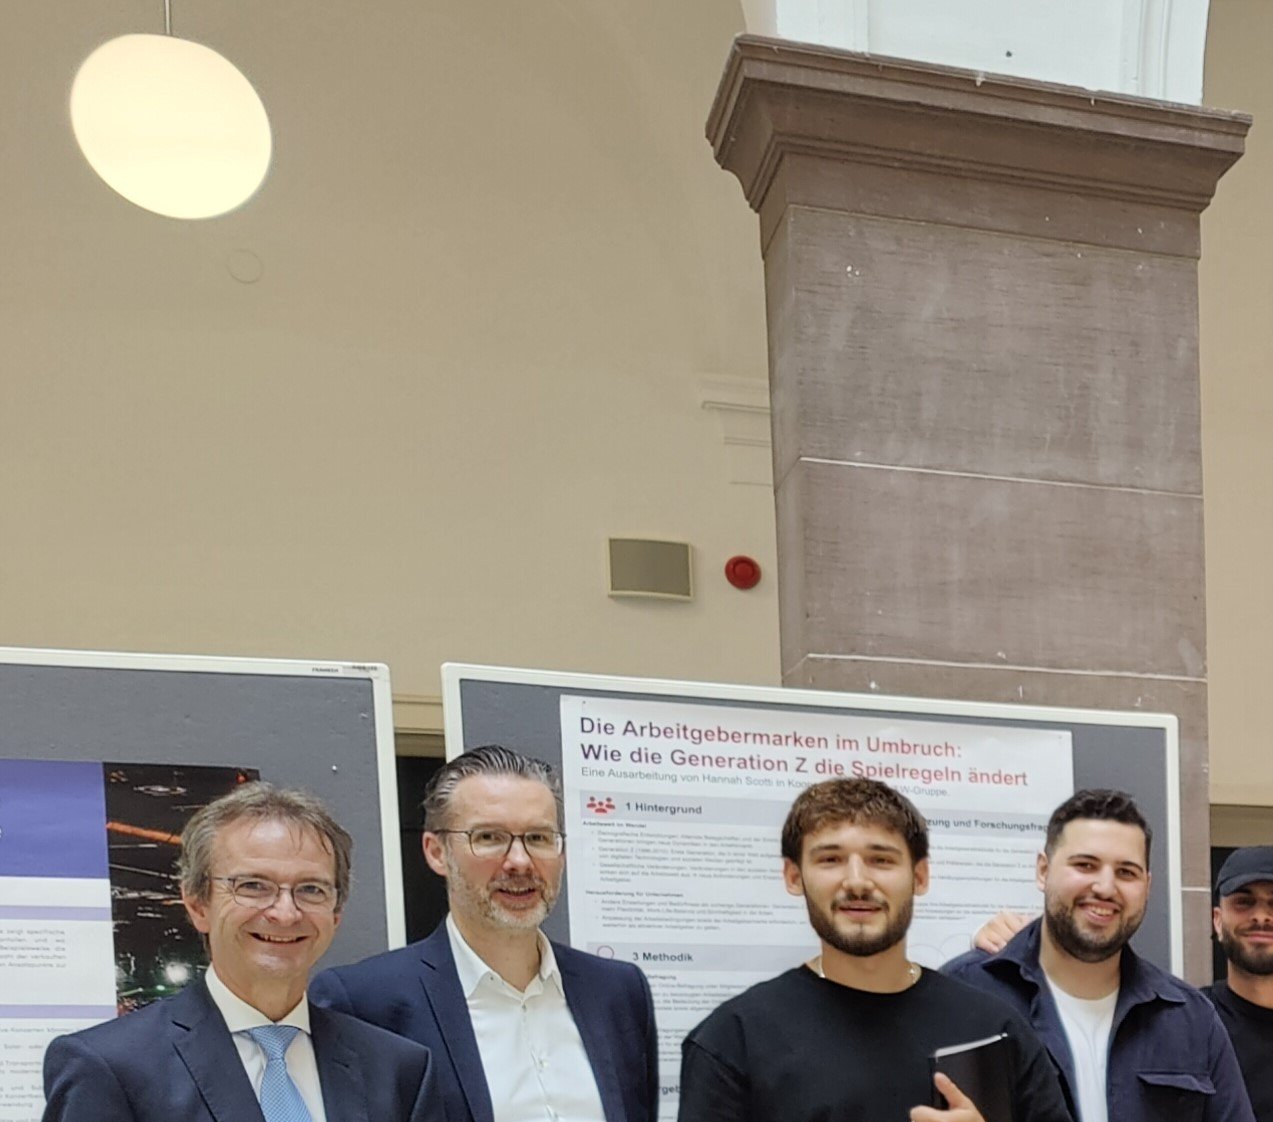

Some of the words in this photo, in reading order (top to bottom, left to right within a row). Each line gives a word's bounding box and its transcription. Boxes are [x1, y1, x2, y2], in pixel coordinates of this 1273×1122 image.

[580, 716, 615, 736] Die
[622, 720, 829, 749] Arbeitgebermarken
[836, 734, 859, 750] im
[867, 736, 962, 758] Umbruch:
[581, 743, 622, 762] Wie
[630, 747, 662, 764] die
[670, 749, 788, 772] Generation
[795, 757, 808, 774] Z
[815, 759, 844, 775] die
[851, 760, 962, 784] Spielregeln
[968, 767, 1028, 786] ändert
[581, 767, 606, 778] Eine
[607, 768, 678, 783] Ausarbeitung
[702, 774, 743, 785] Hannah
[893, 785, 950, 798] W-Gruppe.
[626, 802, 631, 811] 1
[635, 803, 703, 815] Hintergrund
[953, 819, 972, 828] und
[974, 820, 1048, 833] Forschungsfrag
[632, 952, 639, 961] 3
[642, 951, 694, 962] Methodik
